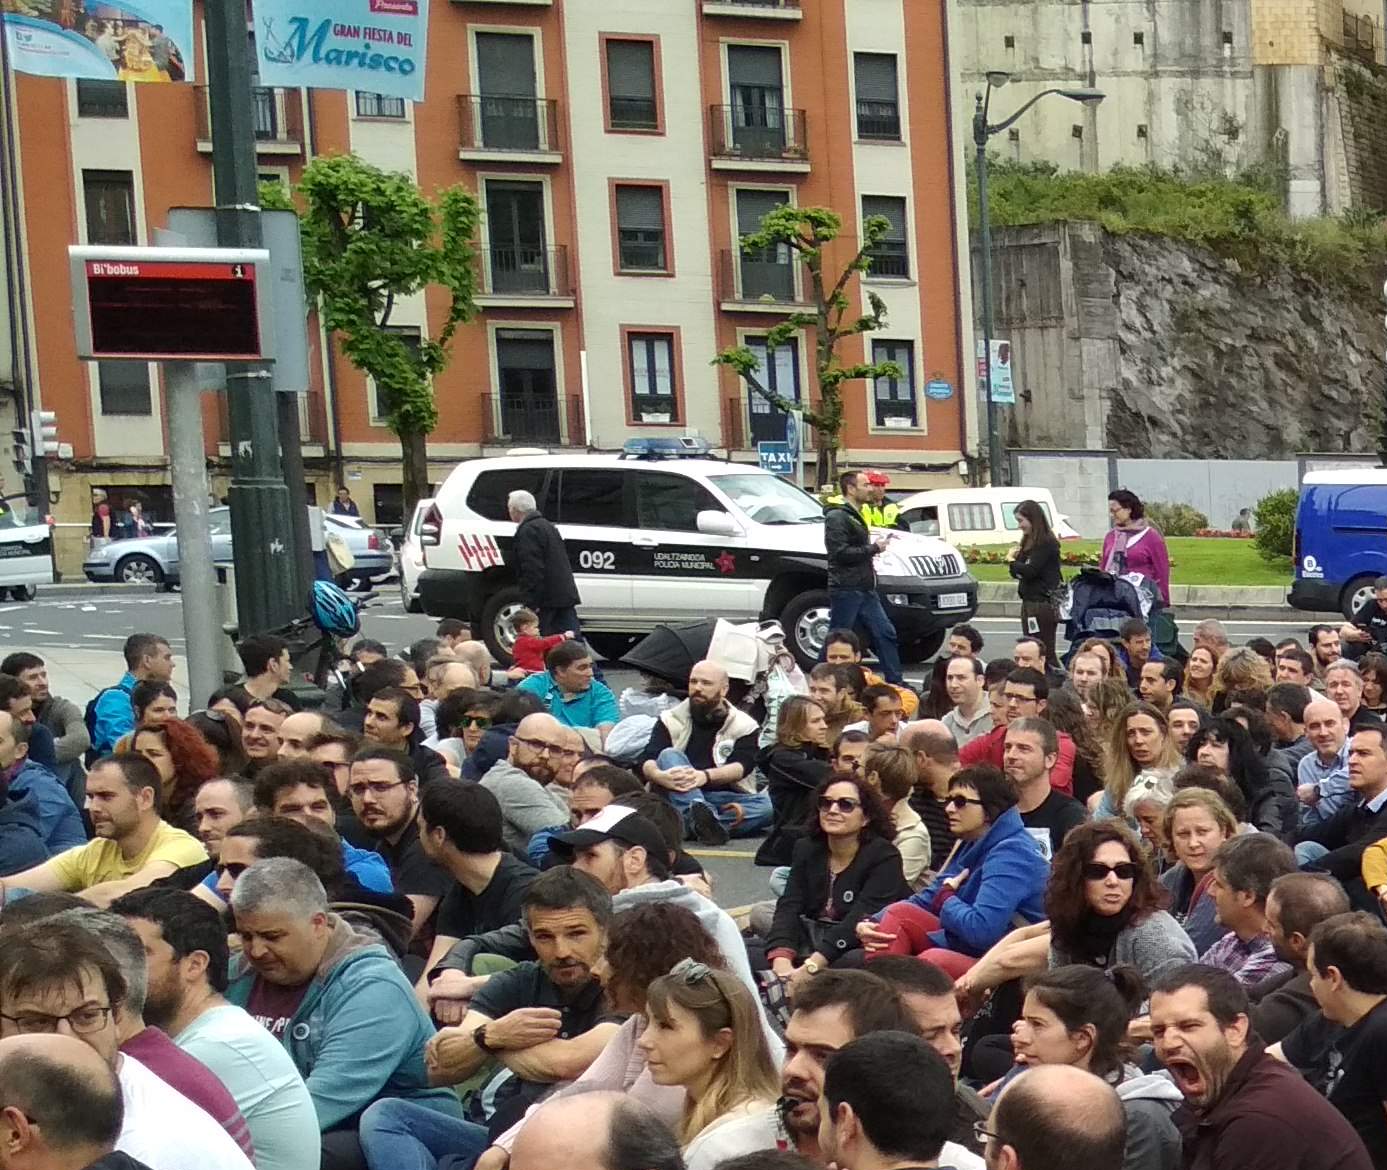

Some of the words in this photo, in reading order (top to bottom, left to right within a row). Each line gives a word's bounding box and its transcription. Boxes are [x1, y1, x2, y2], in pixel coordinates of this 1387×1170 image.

[284, 16, 415, 75] Marisco
[333, 23, 361, 39] GRAN
[363, 27, 394, 44] FIESTA
[396, 31, 413, 47] DEL
[760, 452, 791, 463] TAXI
[579, 551, 616, 570] 092
